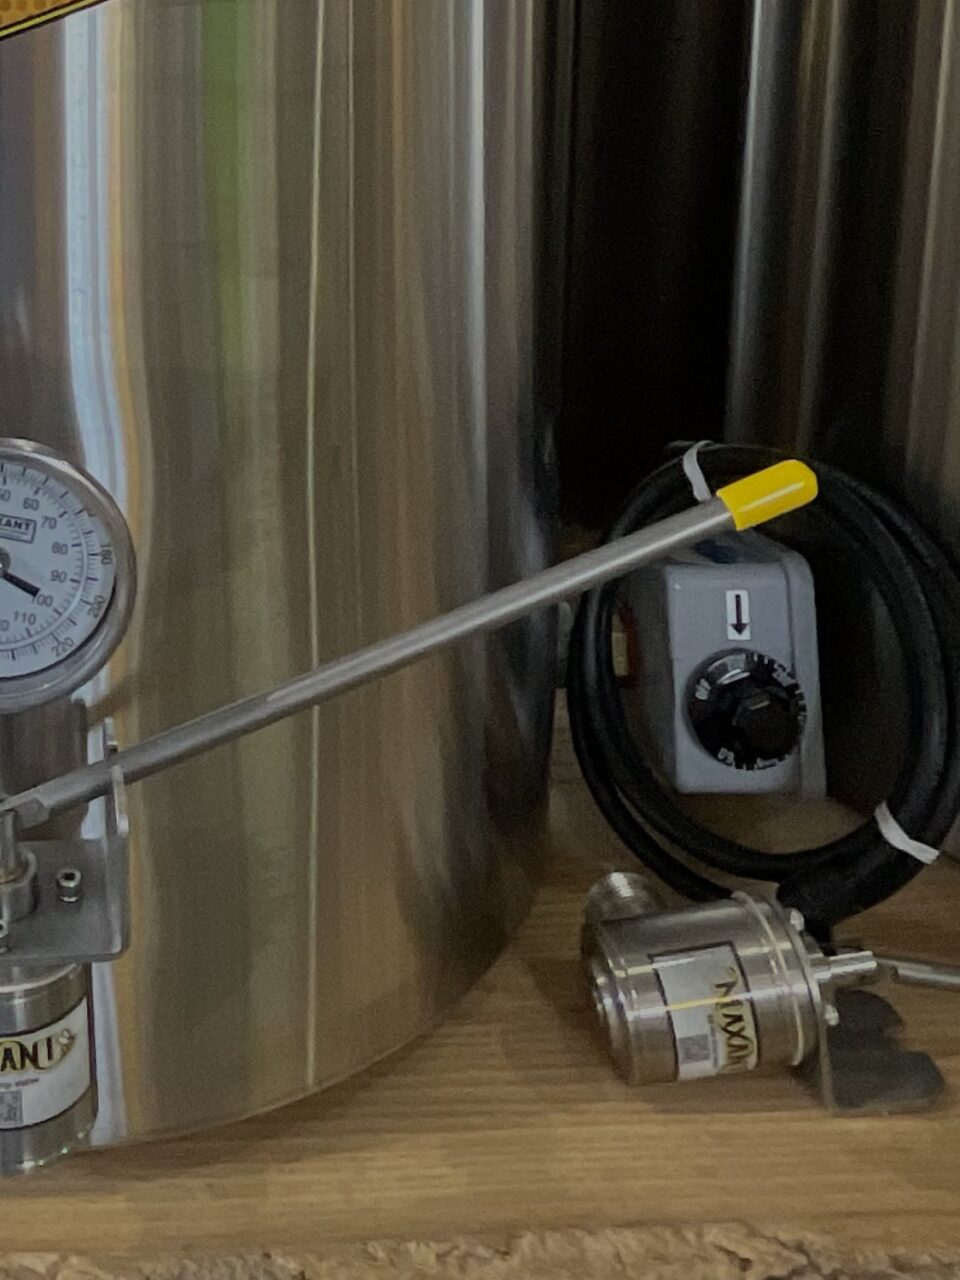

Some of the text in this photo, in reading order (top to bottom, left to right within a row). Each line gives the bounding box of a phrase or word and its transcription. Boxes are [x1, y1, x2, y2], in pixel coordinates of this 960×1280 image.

[23, 497, 40, 511] 60
[41, 515, 58, 530] 70
[50, 569, 68, 584] 90
[13, 610, 37, 626] 110
